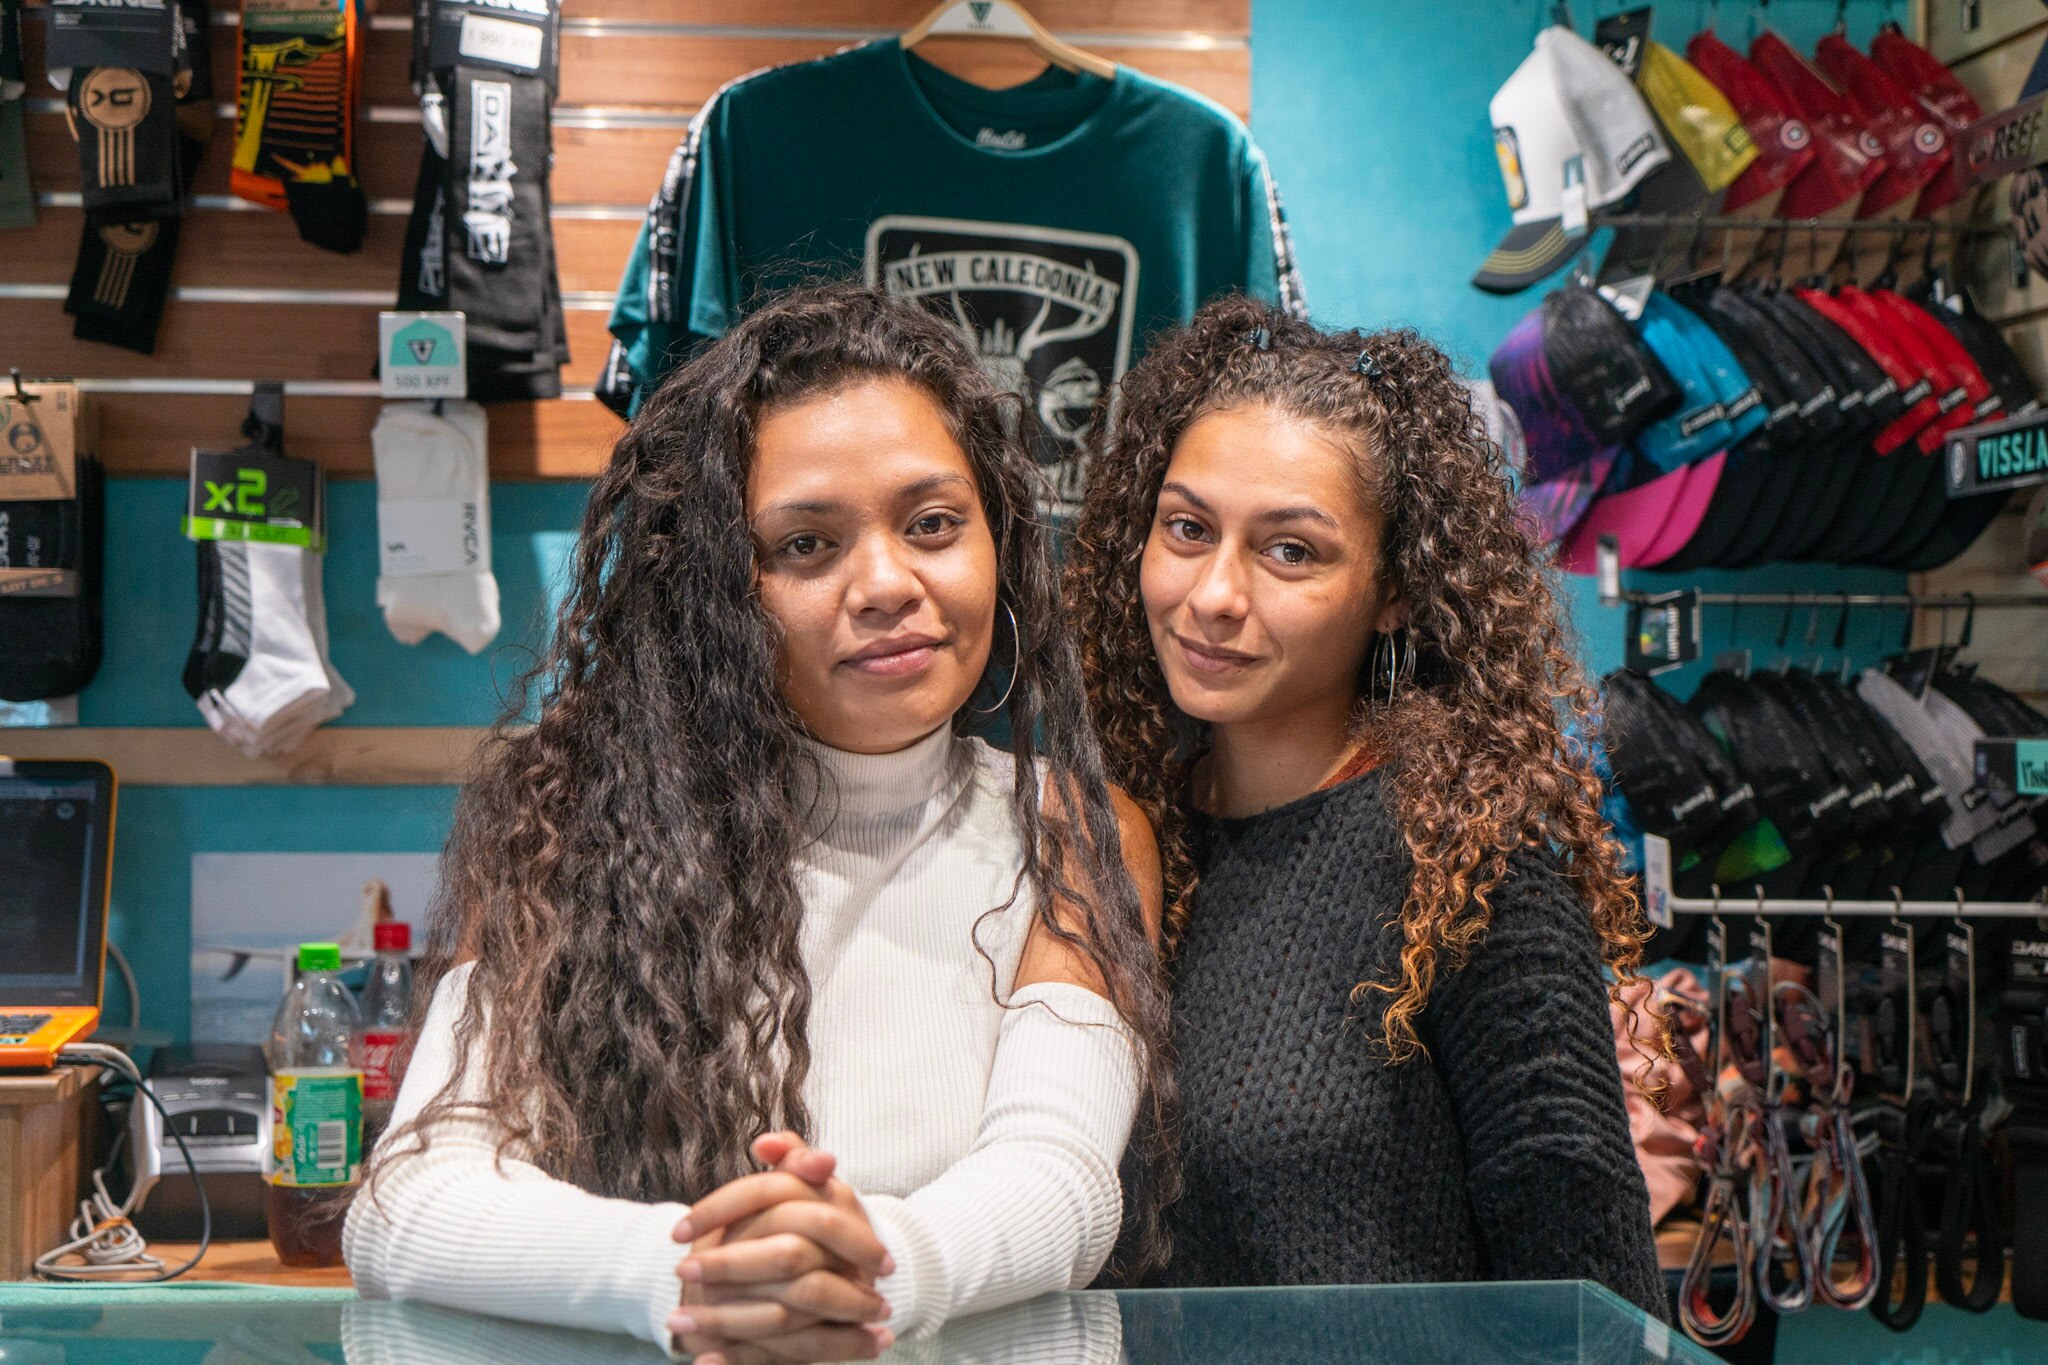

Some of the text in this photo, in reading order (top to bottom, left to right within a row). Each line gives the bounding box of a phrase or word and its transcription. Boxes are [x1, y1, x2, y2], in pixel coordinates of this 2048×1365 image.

[896, 256, 1106, 308] NEW CALEDONIA
[1977, 427, 2048, 479] VISSLA
[202, 466, 268, 517] x2
[462, 502, 479, 568] RVCA
